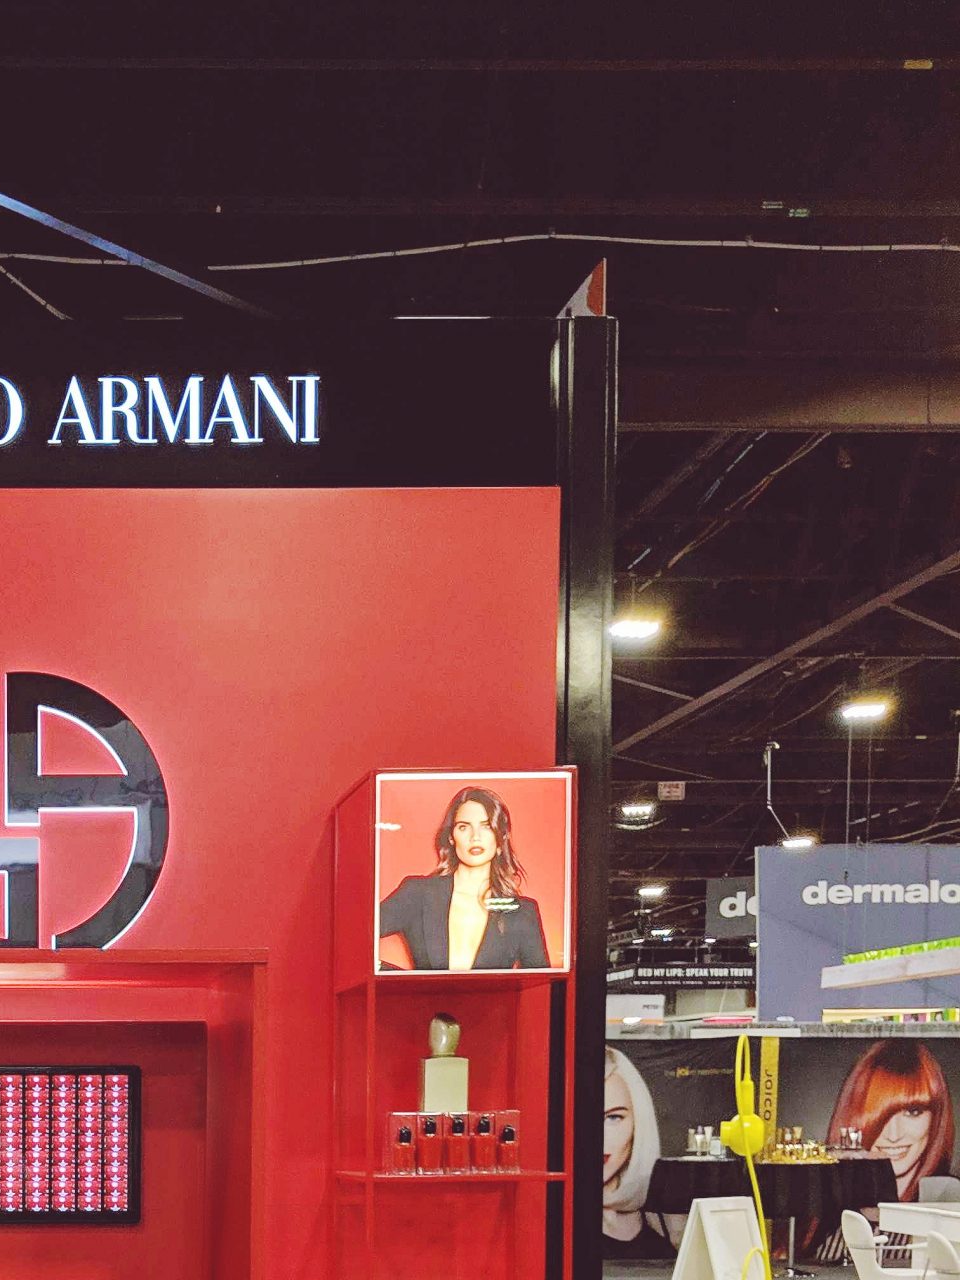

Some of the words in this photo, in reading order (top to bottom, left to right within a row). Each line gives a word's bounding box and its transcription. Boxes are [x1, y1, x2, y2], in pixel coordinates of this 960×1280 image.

[47, 374, 321, 445] ARMANI
[653, 967, 665, 977] MY
[685, 967, 709, 977] SPEAK
[763, 1069, 773, 1121] JOICO
